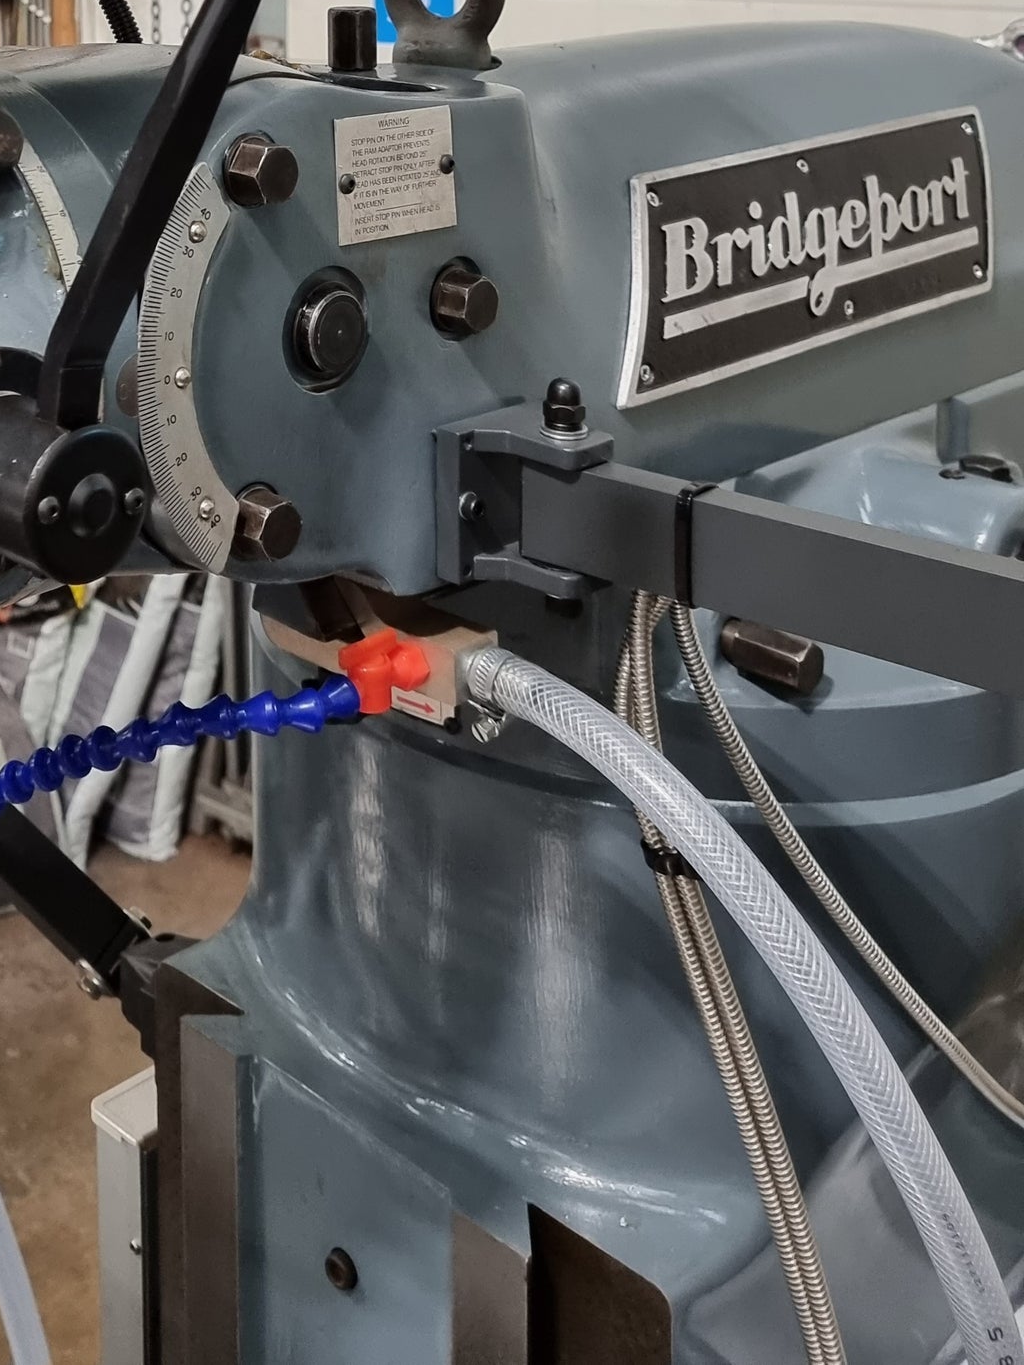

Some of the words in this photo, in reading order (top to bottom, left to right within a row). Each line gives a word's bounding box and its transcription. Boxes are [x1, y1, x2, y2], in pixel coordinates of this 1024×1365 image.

[378, 117, 410, 129] WARNING
[351, 137, 365, 147] STOP
[366, 136, 376, 144] PIN
[376, 135, 385, 143] ON
[397, 131, 415, 139] OTHER
[415, 130, 426, 138] SIDE
[427, 128, 435, 136] OF
[352, 148, 363, 157] THE
[364, 146, 377, 155] RAM
[378, 143, 403, 153] ADAPTOR
[403, 139, 431, 149] PREVENTS
[352, 159, 367, 168] HEAD
[368, 154, 395, 165] ROTATION
[396, 151, 418, 161] BEYOND
[353, 169, 377, 179] RETRACT
[378, 166, 392, 175] STOP
[393, 164, 402, 172] PIN
[403, 162, 417, 171] ONLY
[418, 159, 435, 168] AFTER
[356, 179, 368, 189] EAD
[370, 178, 381, 187] HAS
[382, 175, 396, 185] BEEN
[397, 171, 421, 182] ROTATED
[359, 191, 364, 199] IT
[365, 190, 371, 198] IS
[371, 189, 378, 197] IN
[379, 187, 389, 195] THE
[390, 185, 402, 193] WAY
[403, 183, 410, 191] OF
[411, 180, 437, 190] FURTHER
[353, 199, 385, 211] MOVEMENT
[200, 208, 212, 221] 40
[355, 216, 374, 226] INSERT
[375, 212, 390, 222] STOP
[391, 210, 401, 219] PIN
[402, 207, 418, 217] WHEN
[419, 204, 434, 214] HEAD
[435, 203, 441, 211] IS
[355, 228, 362, 236] IN
[661, 157, 970, 316] Bridgeport
[182, 246, 194, 258] 30
[170, 287, 183, 298] 20
[164, 331, 174, 341] 10
[164, 375, 171, 385] 0
[166, 414, 177, 426] 10
[175, 452, 188, 466] 20
[190, 486, 202, 501] 30
[210, 514, 221, 528] 40
